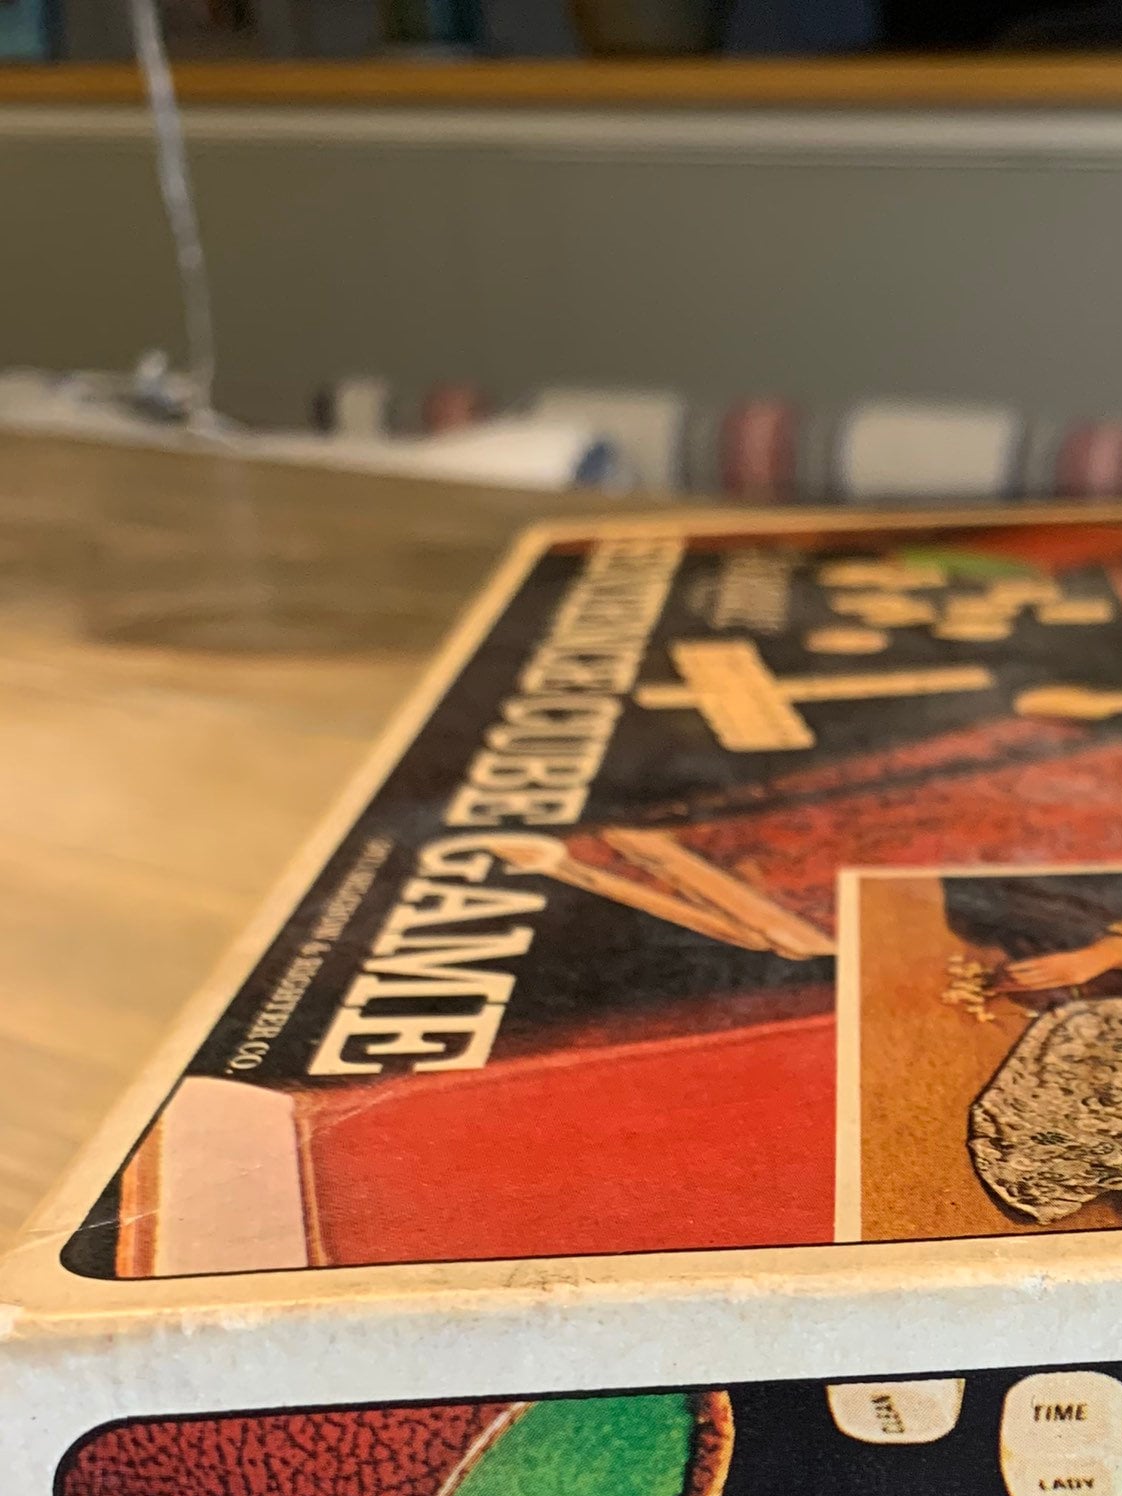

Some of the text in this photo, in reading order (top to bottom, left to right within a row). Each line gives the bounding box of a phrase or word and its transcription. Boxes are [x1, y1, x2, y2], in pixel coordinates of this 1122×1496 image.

[446, 695, 625, 825] CUBE
[308, 832, 567, 1075] GAME
[224, 1039, 271, 1075] CO.
[1033, 1402, 1089, 1423] TIME
